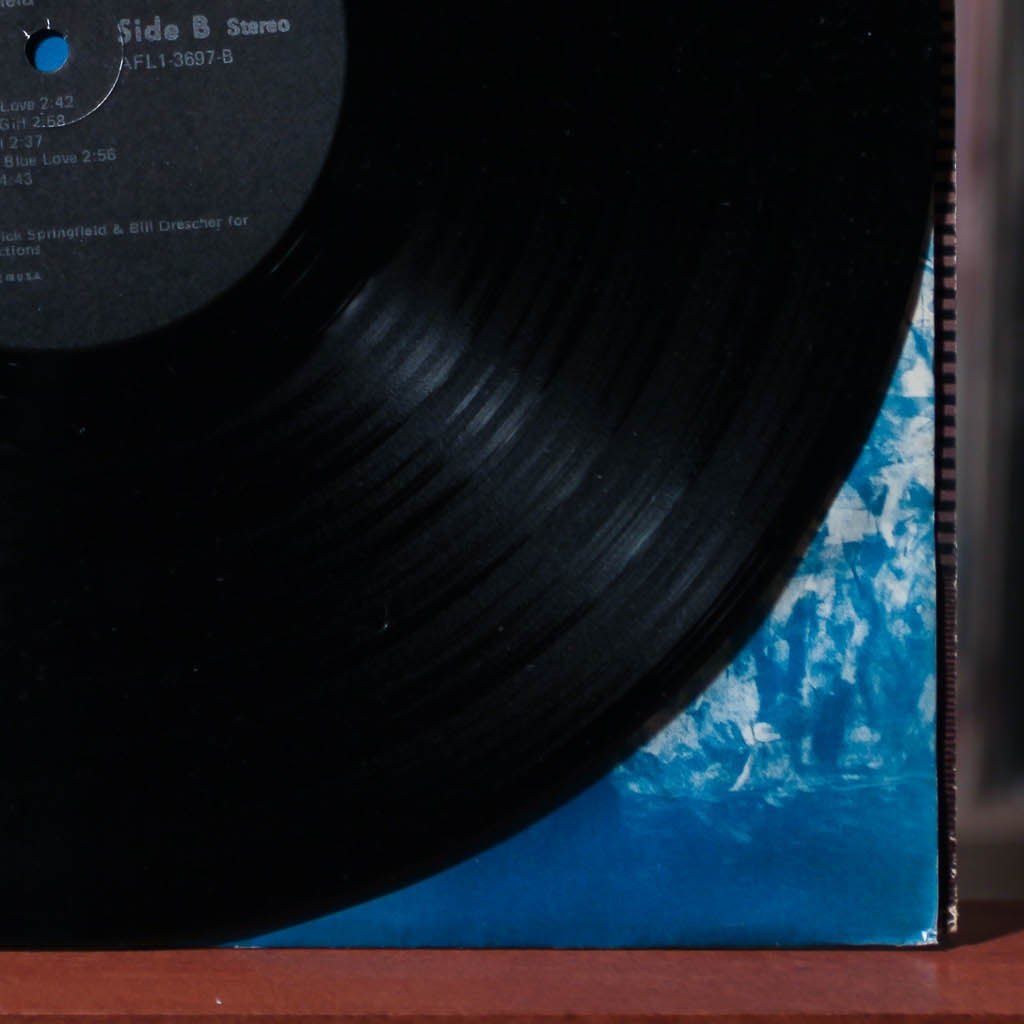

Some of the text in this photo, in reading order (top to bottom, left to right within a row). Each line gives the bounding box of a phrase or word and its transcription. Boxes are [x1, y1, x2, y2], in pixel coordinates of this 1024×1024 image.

[116, 14, 291, 44] Side B Stereo
[0, 99, 36, 113] Love
[39, 95, 75, 110] 2:42
[3, 154, 36, 169] Blue
[42, 152, 78, 166] Love
[128, 220, 154, 234] Bill
[159, 216, 223, 233] Drescher
[227, 214, 250, 227] for
